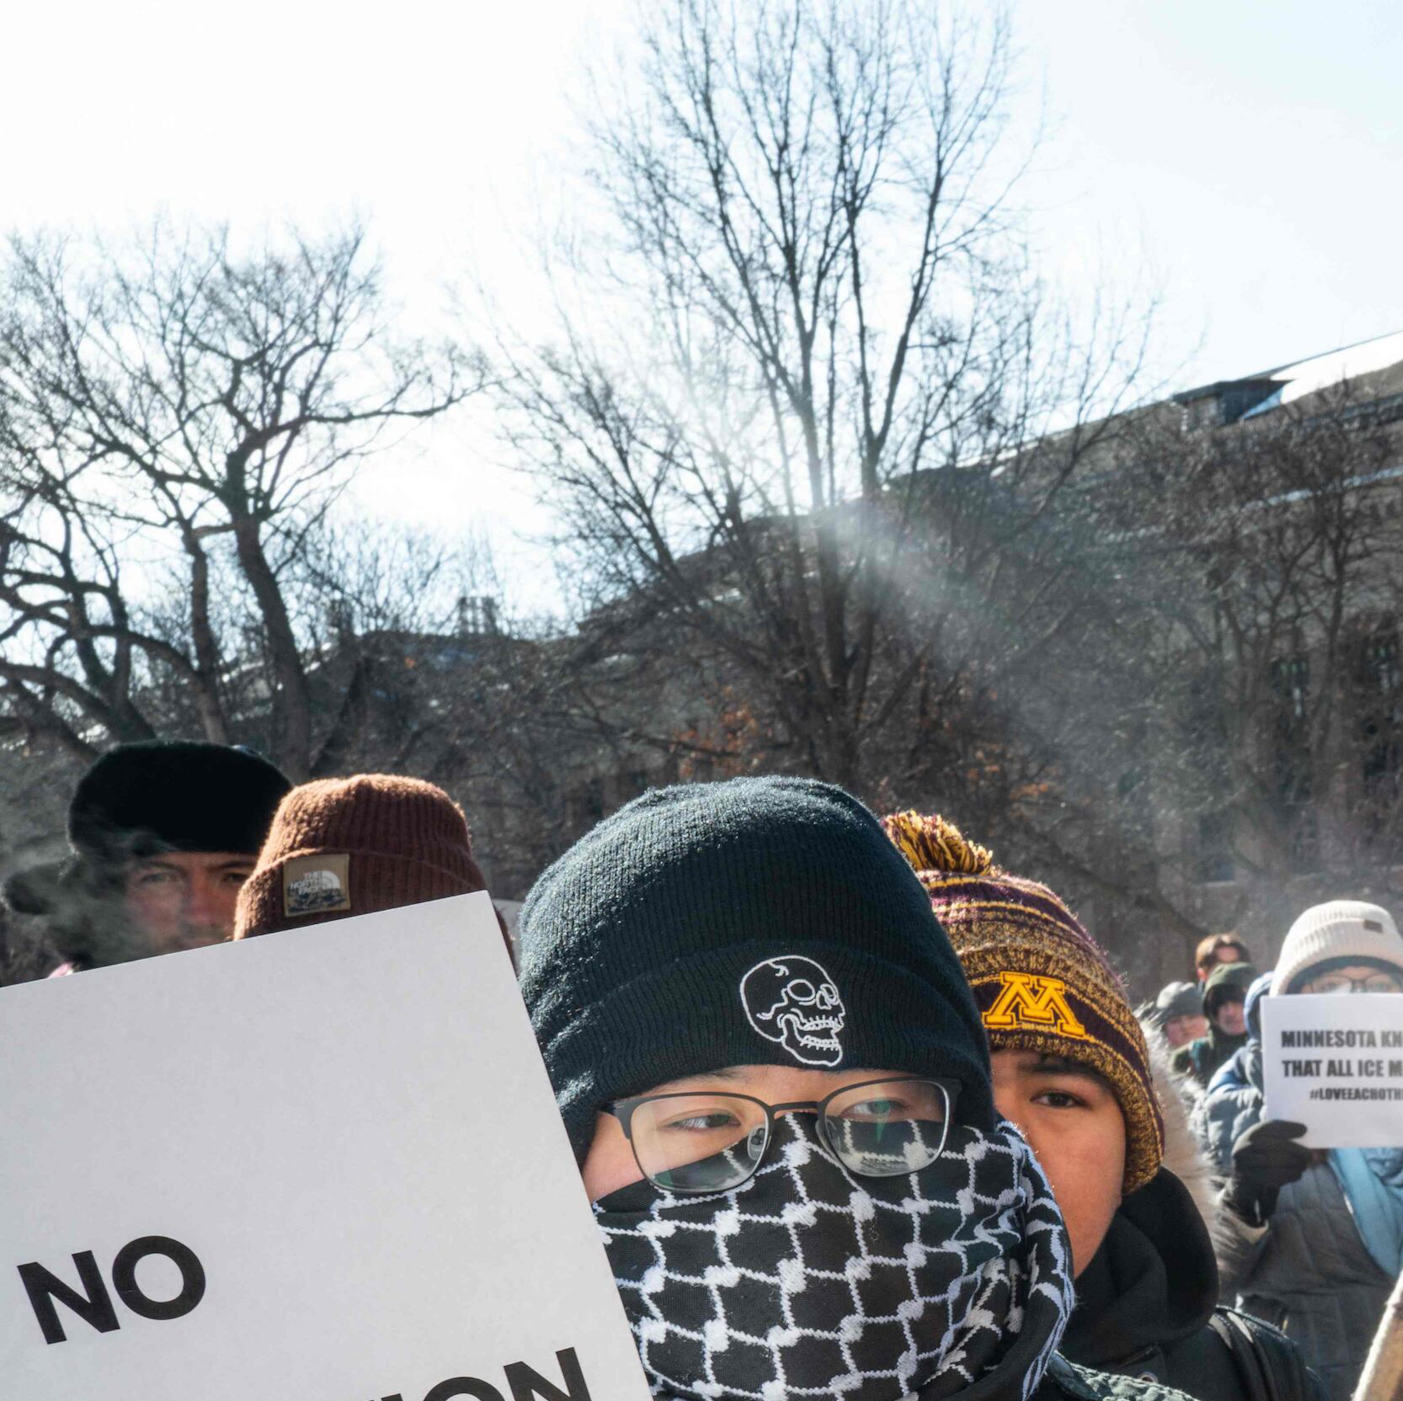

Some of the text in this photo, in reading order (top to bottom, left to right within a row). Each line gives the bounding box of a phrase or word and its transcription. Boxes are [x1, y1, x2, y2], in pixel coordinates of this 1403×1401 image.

[1281, 1030, 1377, 1048] MINNESOTA
[1282, 1060, 1322, 1077] THAT
[1326, 1060, 1353, 1077] ALL
[1358, 1060, 1384, 1077] ICE
[17, 1236, 206, 1344] NO
